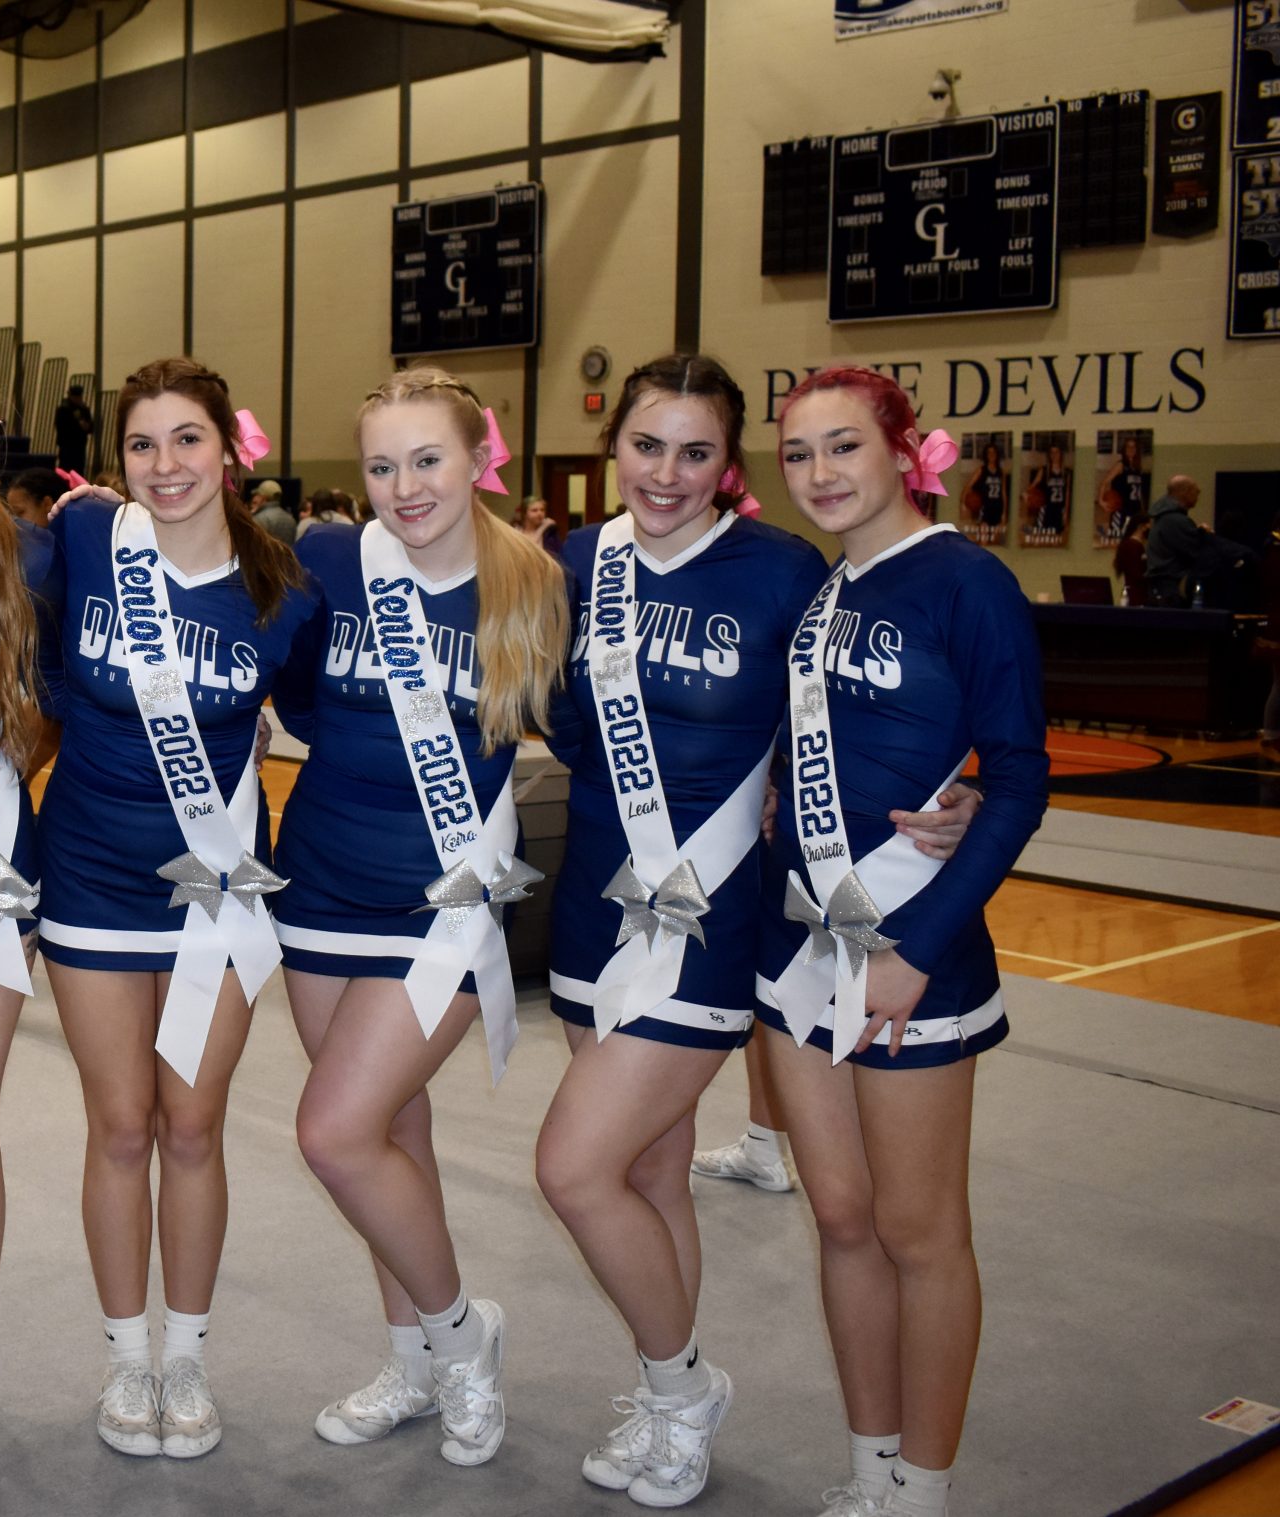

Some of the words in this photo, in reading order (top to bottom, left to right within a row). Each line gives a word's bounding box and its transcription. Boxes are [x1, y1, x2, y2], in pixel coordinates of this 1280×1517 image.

[1067, 100, 1082, 112] NO
[1120, 91, 1141, 105] PTS
[840, 136, 879, 155] HOME
[998, 111, 1055, 132] VISITOR
[911, 177, 948, 192] PERIOD
[995, 175, 1031, 190] BONUS
[996, 193, 1049, 210] TIMEOUTS
[837, 212, 884, 227] TIMEOUTS
[1009, 237, 1034, 250] LEFT
[847, 253, 869, 265] LEFT
[904, 262, 940, 276] PLAYER
[948, 258, 980, 271] FOULS
[1000, 254, 1034, 268] FOULS
[846, 268, 876, 281] FOULS
[1238, 271, 1280, 289] CROSS
[943, 347, 1207, 419] DEVILS
[594, 542, 635, 648] Senior
[570, 600, 741, 678] DVILS
[824, 608, 903, 690] ILS
[325, 611, 480, 702] DEIL
[115, 546, 167, 666] Senior
[148, 714, 212, 799] 2022
[646, 667, 712, 690] LAKE
[93, 666, 133, 686] GUL
[196, 691, 237, 705] AKE
[342, 683, 385, 695] GUL
[450, 700, 476, 717] AK
[368, 577, 427, 691] Senior
[410, 733, 474, 830] 2022
[601, 694, 655, 794] 2022
[797, 730, 838, 838] 2022
[184, 802, 216, 819] Brie
[627, 797, 660, 821] Leah
[803, 841, 846, 863] Charlotte
